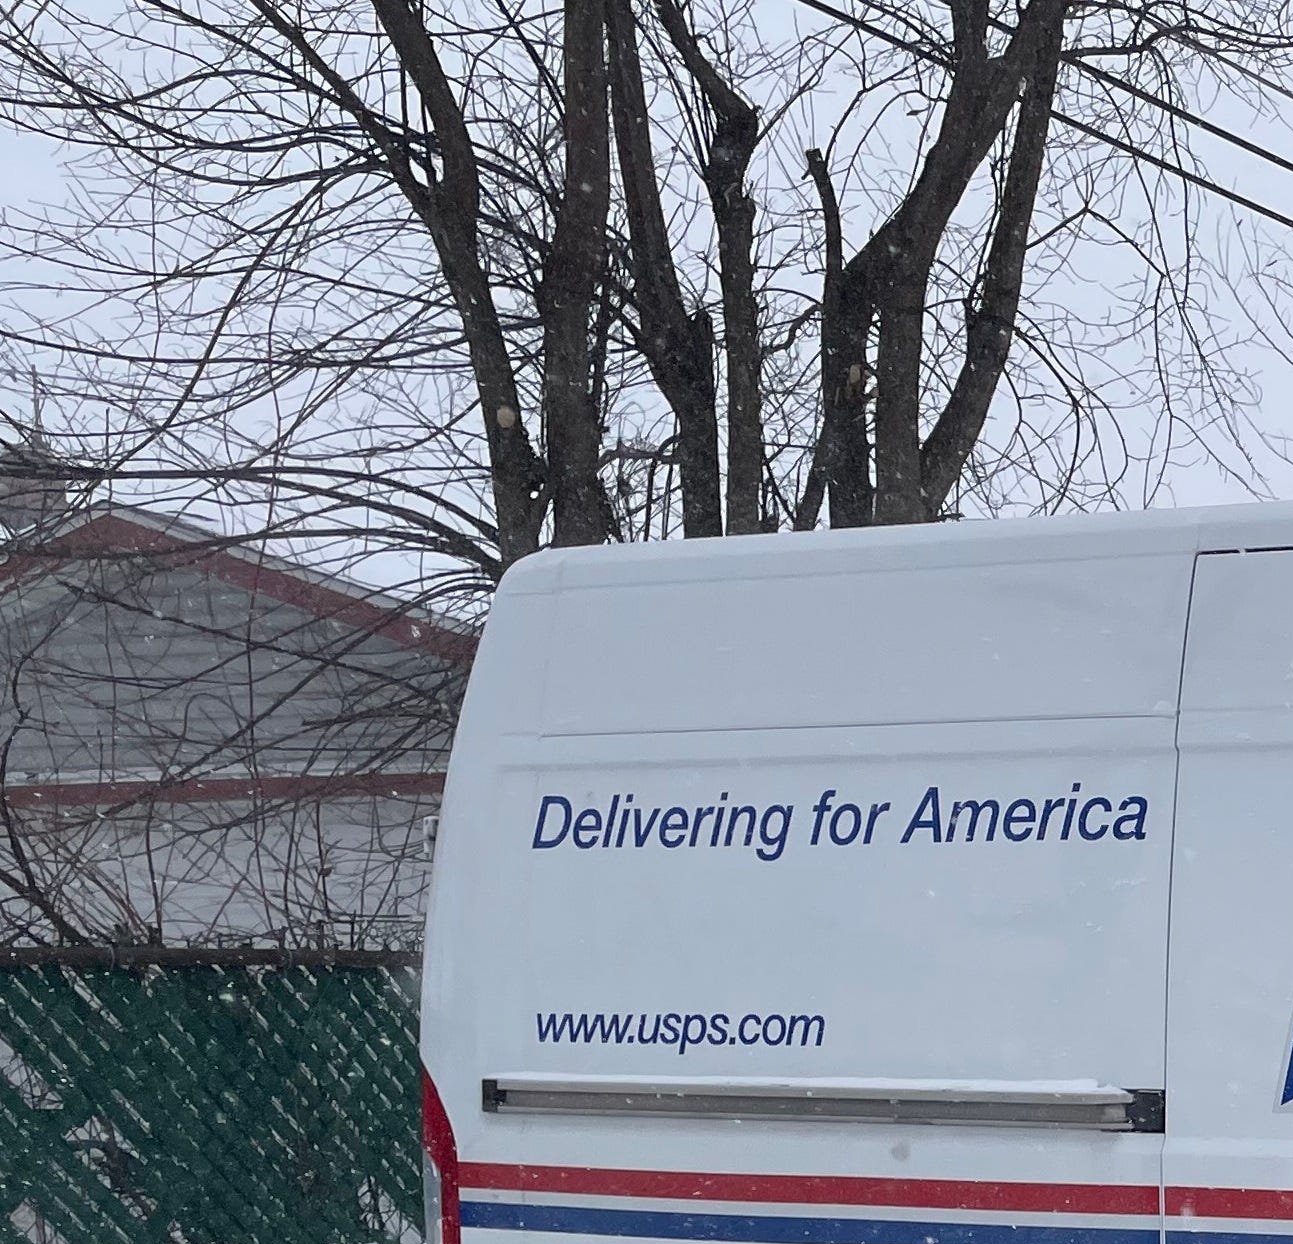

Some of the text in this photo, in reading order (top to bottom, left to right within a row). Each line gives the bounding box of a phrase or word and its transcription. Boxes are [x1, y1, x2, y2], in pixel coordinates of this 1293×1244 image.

[532, 782, 1150, 861] Delivering for America
[536, 1012, 825, 1055] www.usps.com
